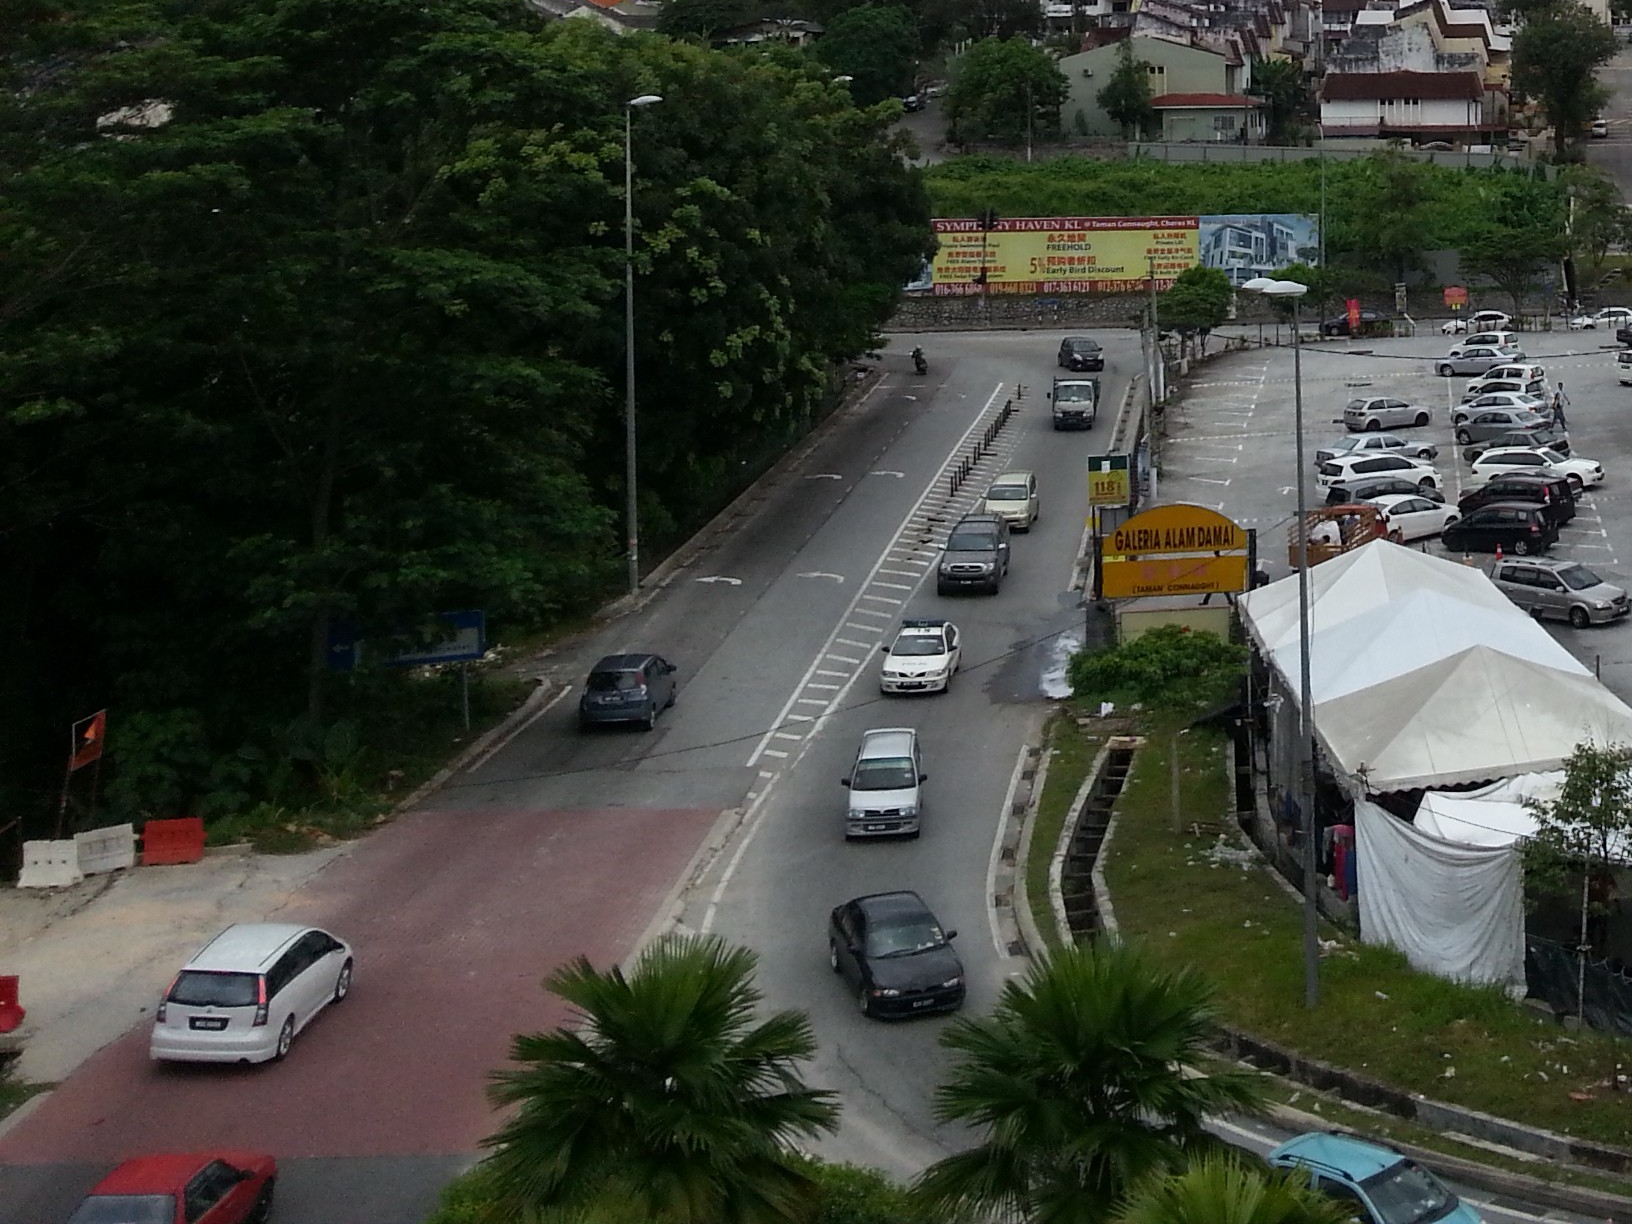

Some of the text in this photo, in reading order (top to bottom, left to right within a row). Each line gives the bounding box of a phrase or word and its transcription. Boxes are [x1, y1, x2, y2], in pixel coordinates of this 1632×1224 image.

[1016, 220, 1060, 230] HAVEN
[1064, 220, 1082, 229] KL
[1046, 243, 1092, 251] FREEHOLD
[1046, 266, 1068, 275] Early
[1088, 265, 1124, 273] Discount
[1094, 481, 1115, 493] 118
[1115, 524, 1235, 551] GALERIA ALAM DAMAI
